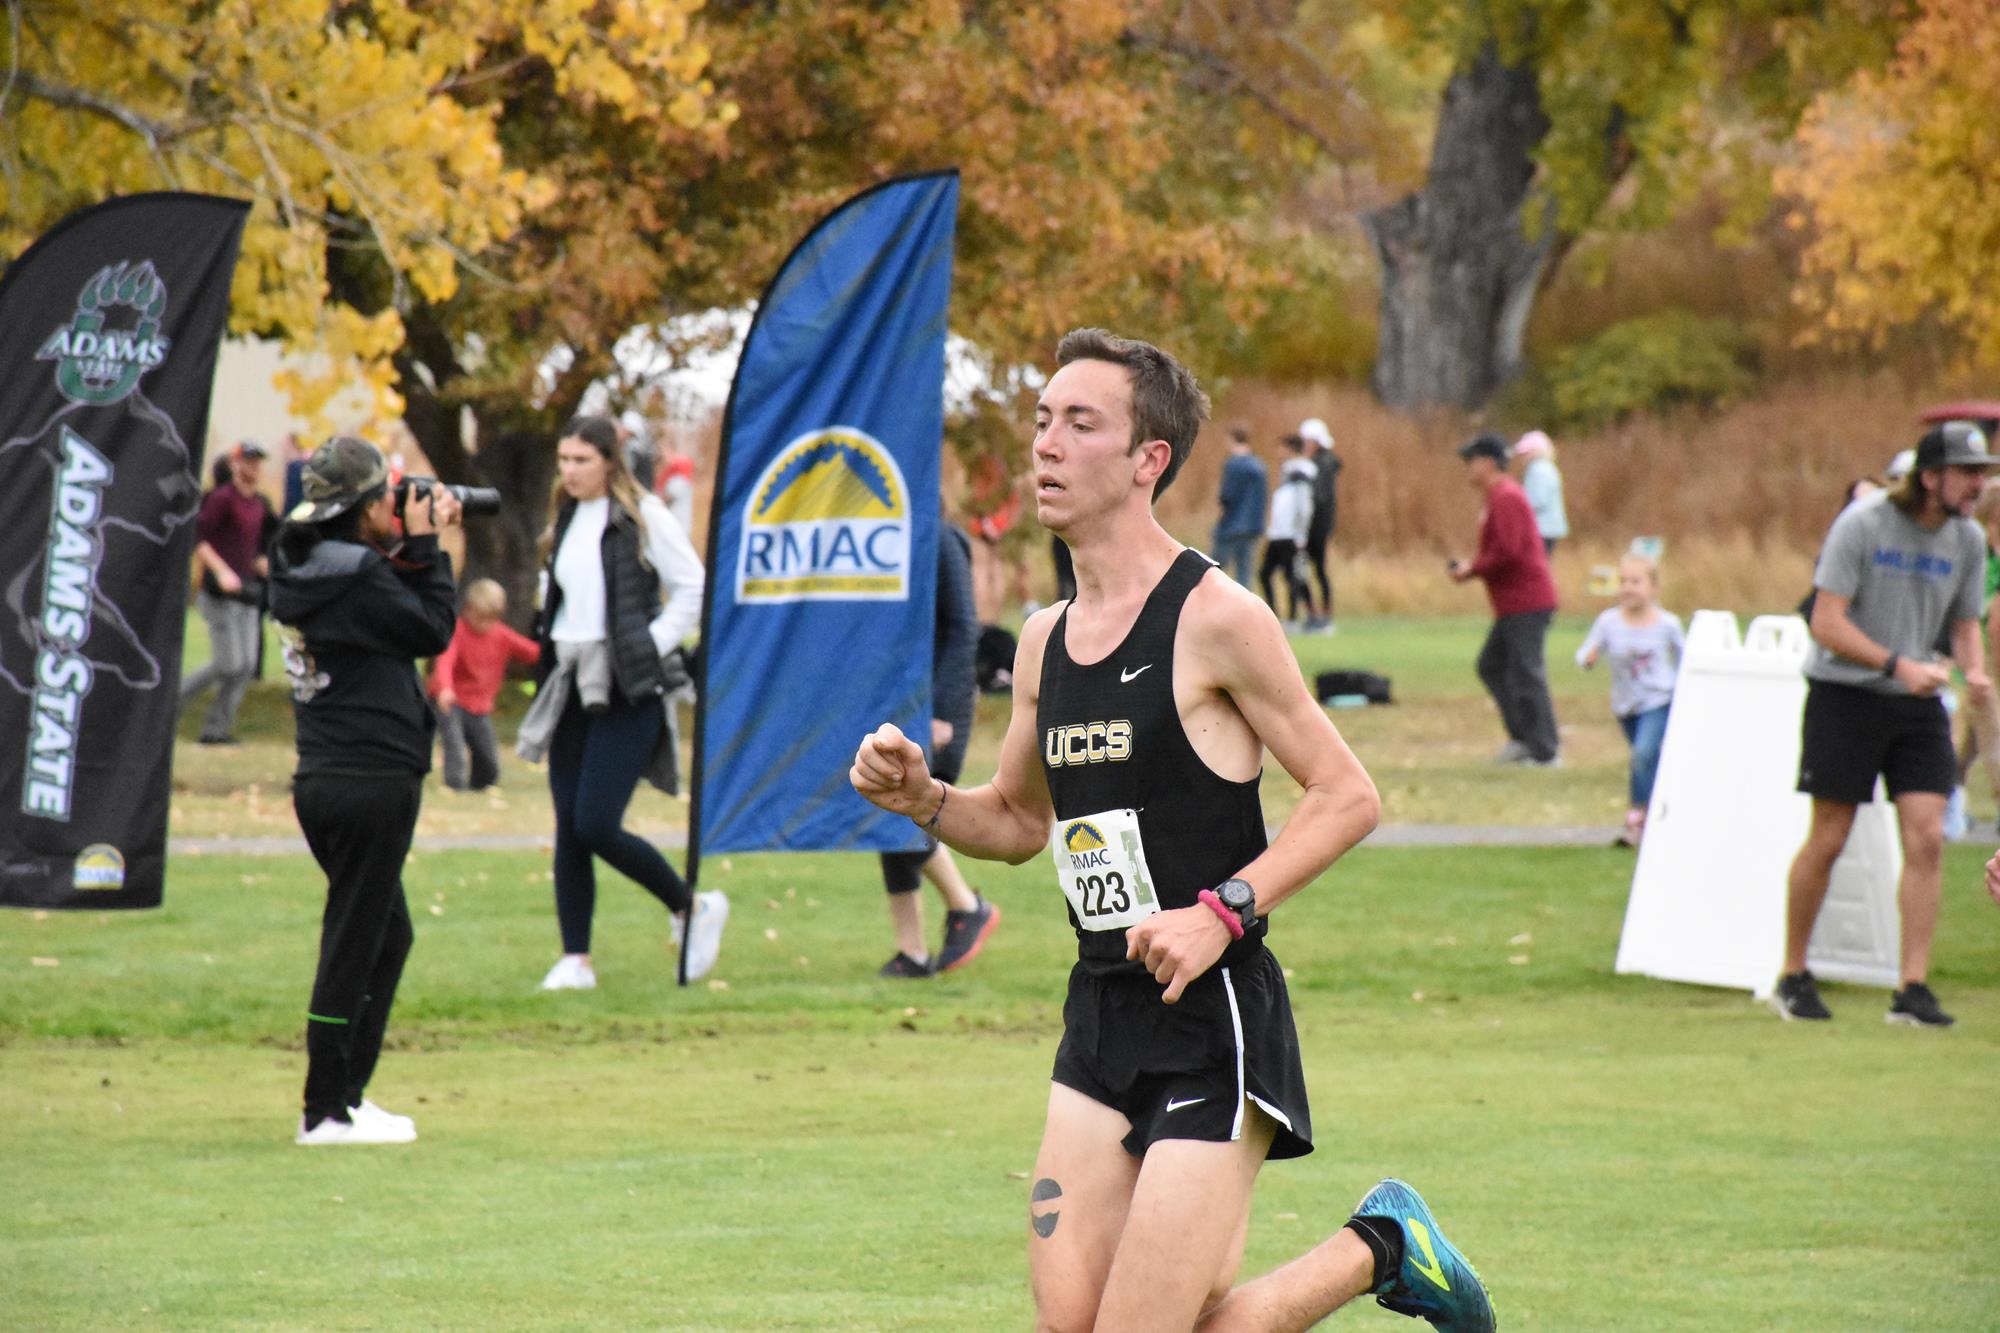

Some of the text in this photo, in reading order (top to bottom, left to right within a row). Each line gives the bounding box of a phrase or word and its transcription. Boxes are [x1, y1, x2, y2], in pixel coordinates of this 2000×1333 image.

[37, 328, 168, 367] ADAMS
[43, 428, 112, 648] ADAMS
[745, 525, 902, 573] RMAC
[24, 652, 92, 819] STATE
[1046, 719, 1133, 768] UCCS
[1069, 848, 1112, 871] RMAC
[1075, 871, 1131, 917] 223
